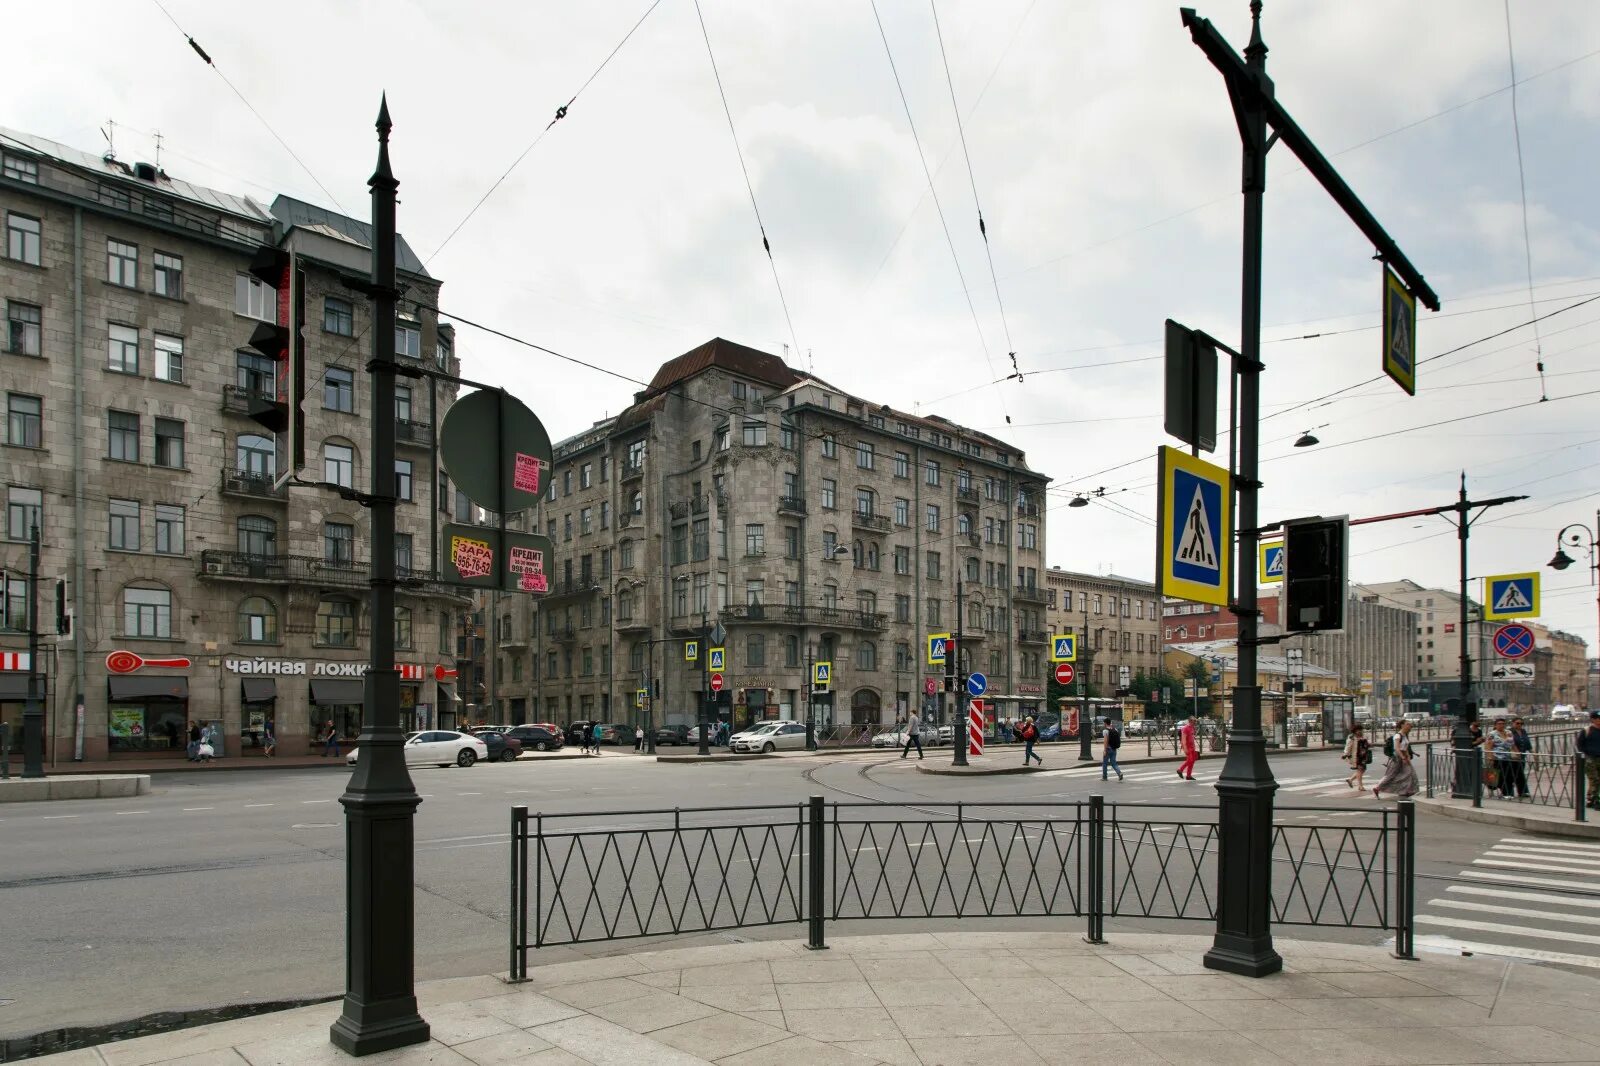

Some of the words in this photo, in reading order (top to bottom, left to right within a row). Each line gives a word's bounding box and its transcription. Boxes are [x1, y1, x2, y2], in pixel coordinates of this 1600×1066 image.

[459, 543, 491, 560] ЗАРА
[512, 548, 542, 561] КРЕДИТ
[457, 555, 490, 574] 956-76-52
[225, 657, 306, 675] чайная
